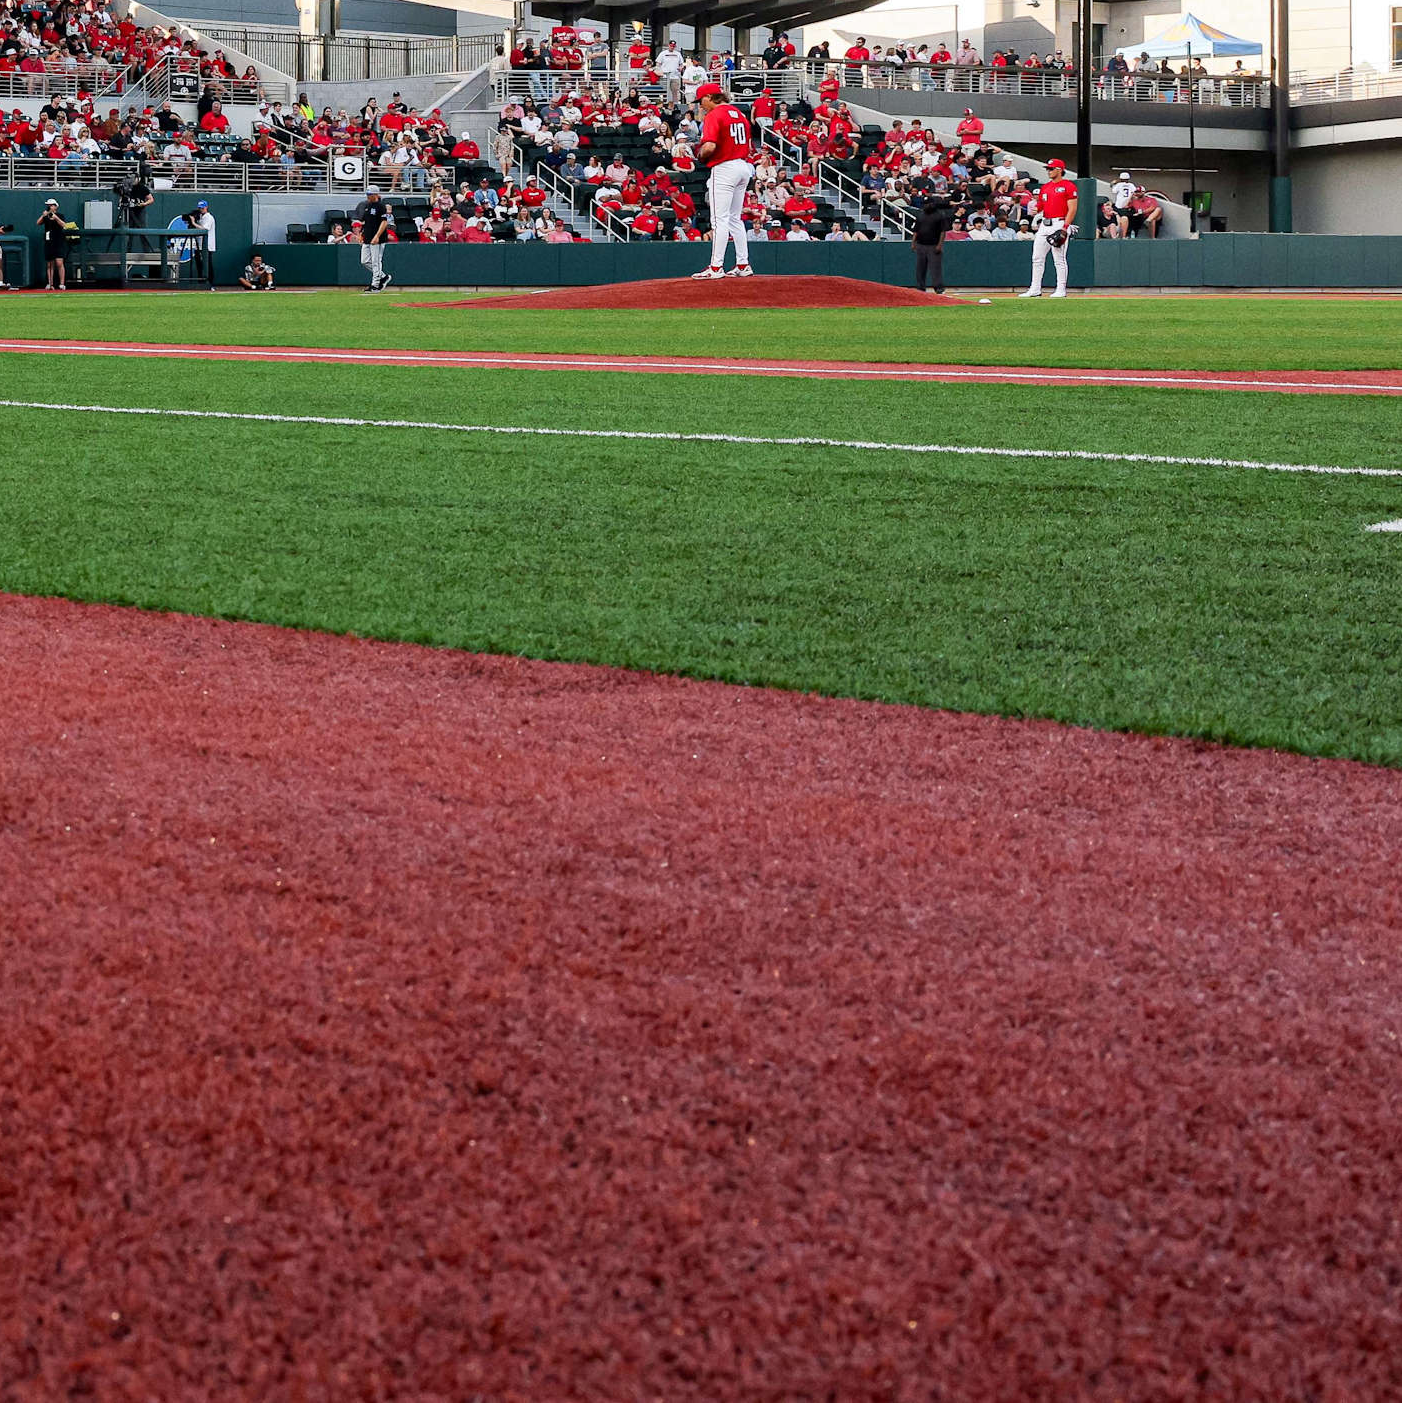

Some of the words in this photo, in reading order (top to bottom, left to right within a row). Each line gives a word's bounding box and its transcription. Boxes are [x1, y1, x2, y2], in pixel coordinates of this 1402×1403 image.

[730, 123, 746, 145] 40
[341, 163, 356, 175] G
[1123, 188, 1129, 197] 3
